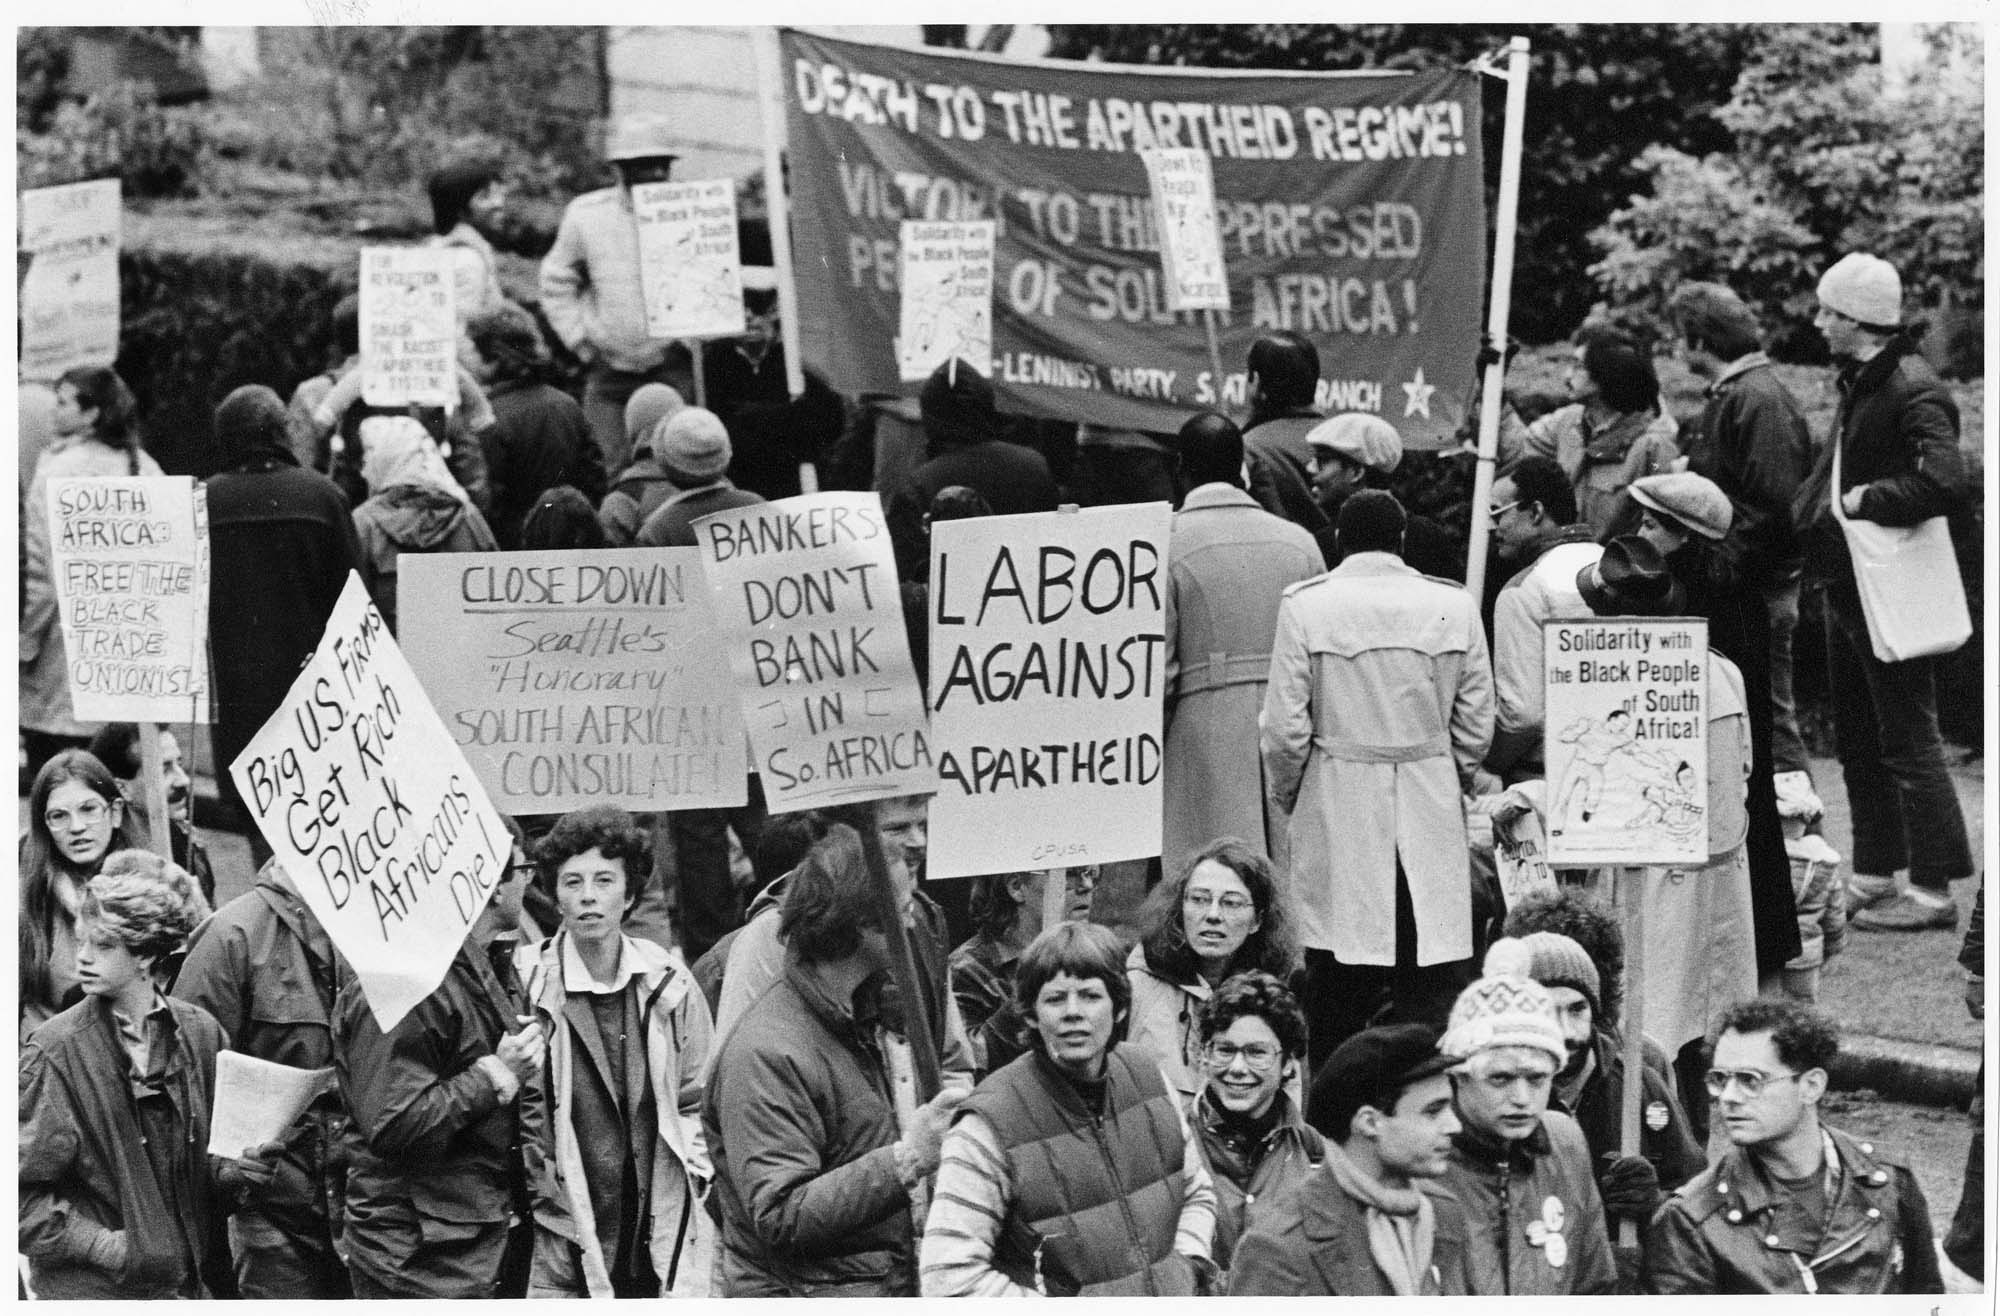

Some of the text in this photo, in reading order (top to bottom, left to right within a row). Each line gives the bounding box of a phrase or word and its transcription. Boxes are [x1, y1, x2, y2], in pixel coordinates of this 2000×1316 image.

[795, 58, 918, 133] DEATH
[925, 84, 985, 141] TO
[993, 91, 1080, 149] THE
[1087, 98, 1297, 160] APARTHEID
[1017, 187, 1079, 246] TO
[1214, 200, 1421, 260] PPRESSED
[1008, 259, 1064, 317] OF
[1086, 264, 1231, 326] SOU
[1313, 378, 1381, 412] RANCH
[59, 488, 146, 515] SOUTH
[709, 507, 878, 562] BANKERS
[67, 562, 192, 594] FREE THE
[461, 564, 685, 605] CLOSE DOWN
[744, 564, 878, 625] DON'T
[937, 539, 1161, 627] LABOR
[74, 600, 158, 625] BLACK
[487, 617, 668, 658] Seattle's
[74, 629, 163, 656] TRADE
[751, 626, 879, 687] BANK
[1559, 627, 1693, 654] Solidarity with
[934, 633, 1166, 712] AGAINST
[1550, 660, 1700, 686] the Black People
[454, 704, 728, 747] SOUTH AFRICAN
[804, 692, 844, 735] IN
[1645, 689, 1700, 713] South
[247, 747, 306, 817] Big
[296, 678, 350, 752] U.S.
[826, 729, 933, 779] AFRICA
[1634, 717, 1700, 740] Africa!
[287, 674, 401, 856] Get Rich
[938, 733, 1161, 795] APARTHEID
[317, 777, 412, 910] Black
[370, 775, 471, 942] Africans
[449, 813, 500, 925] Die!
